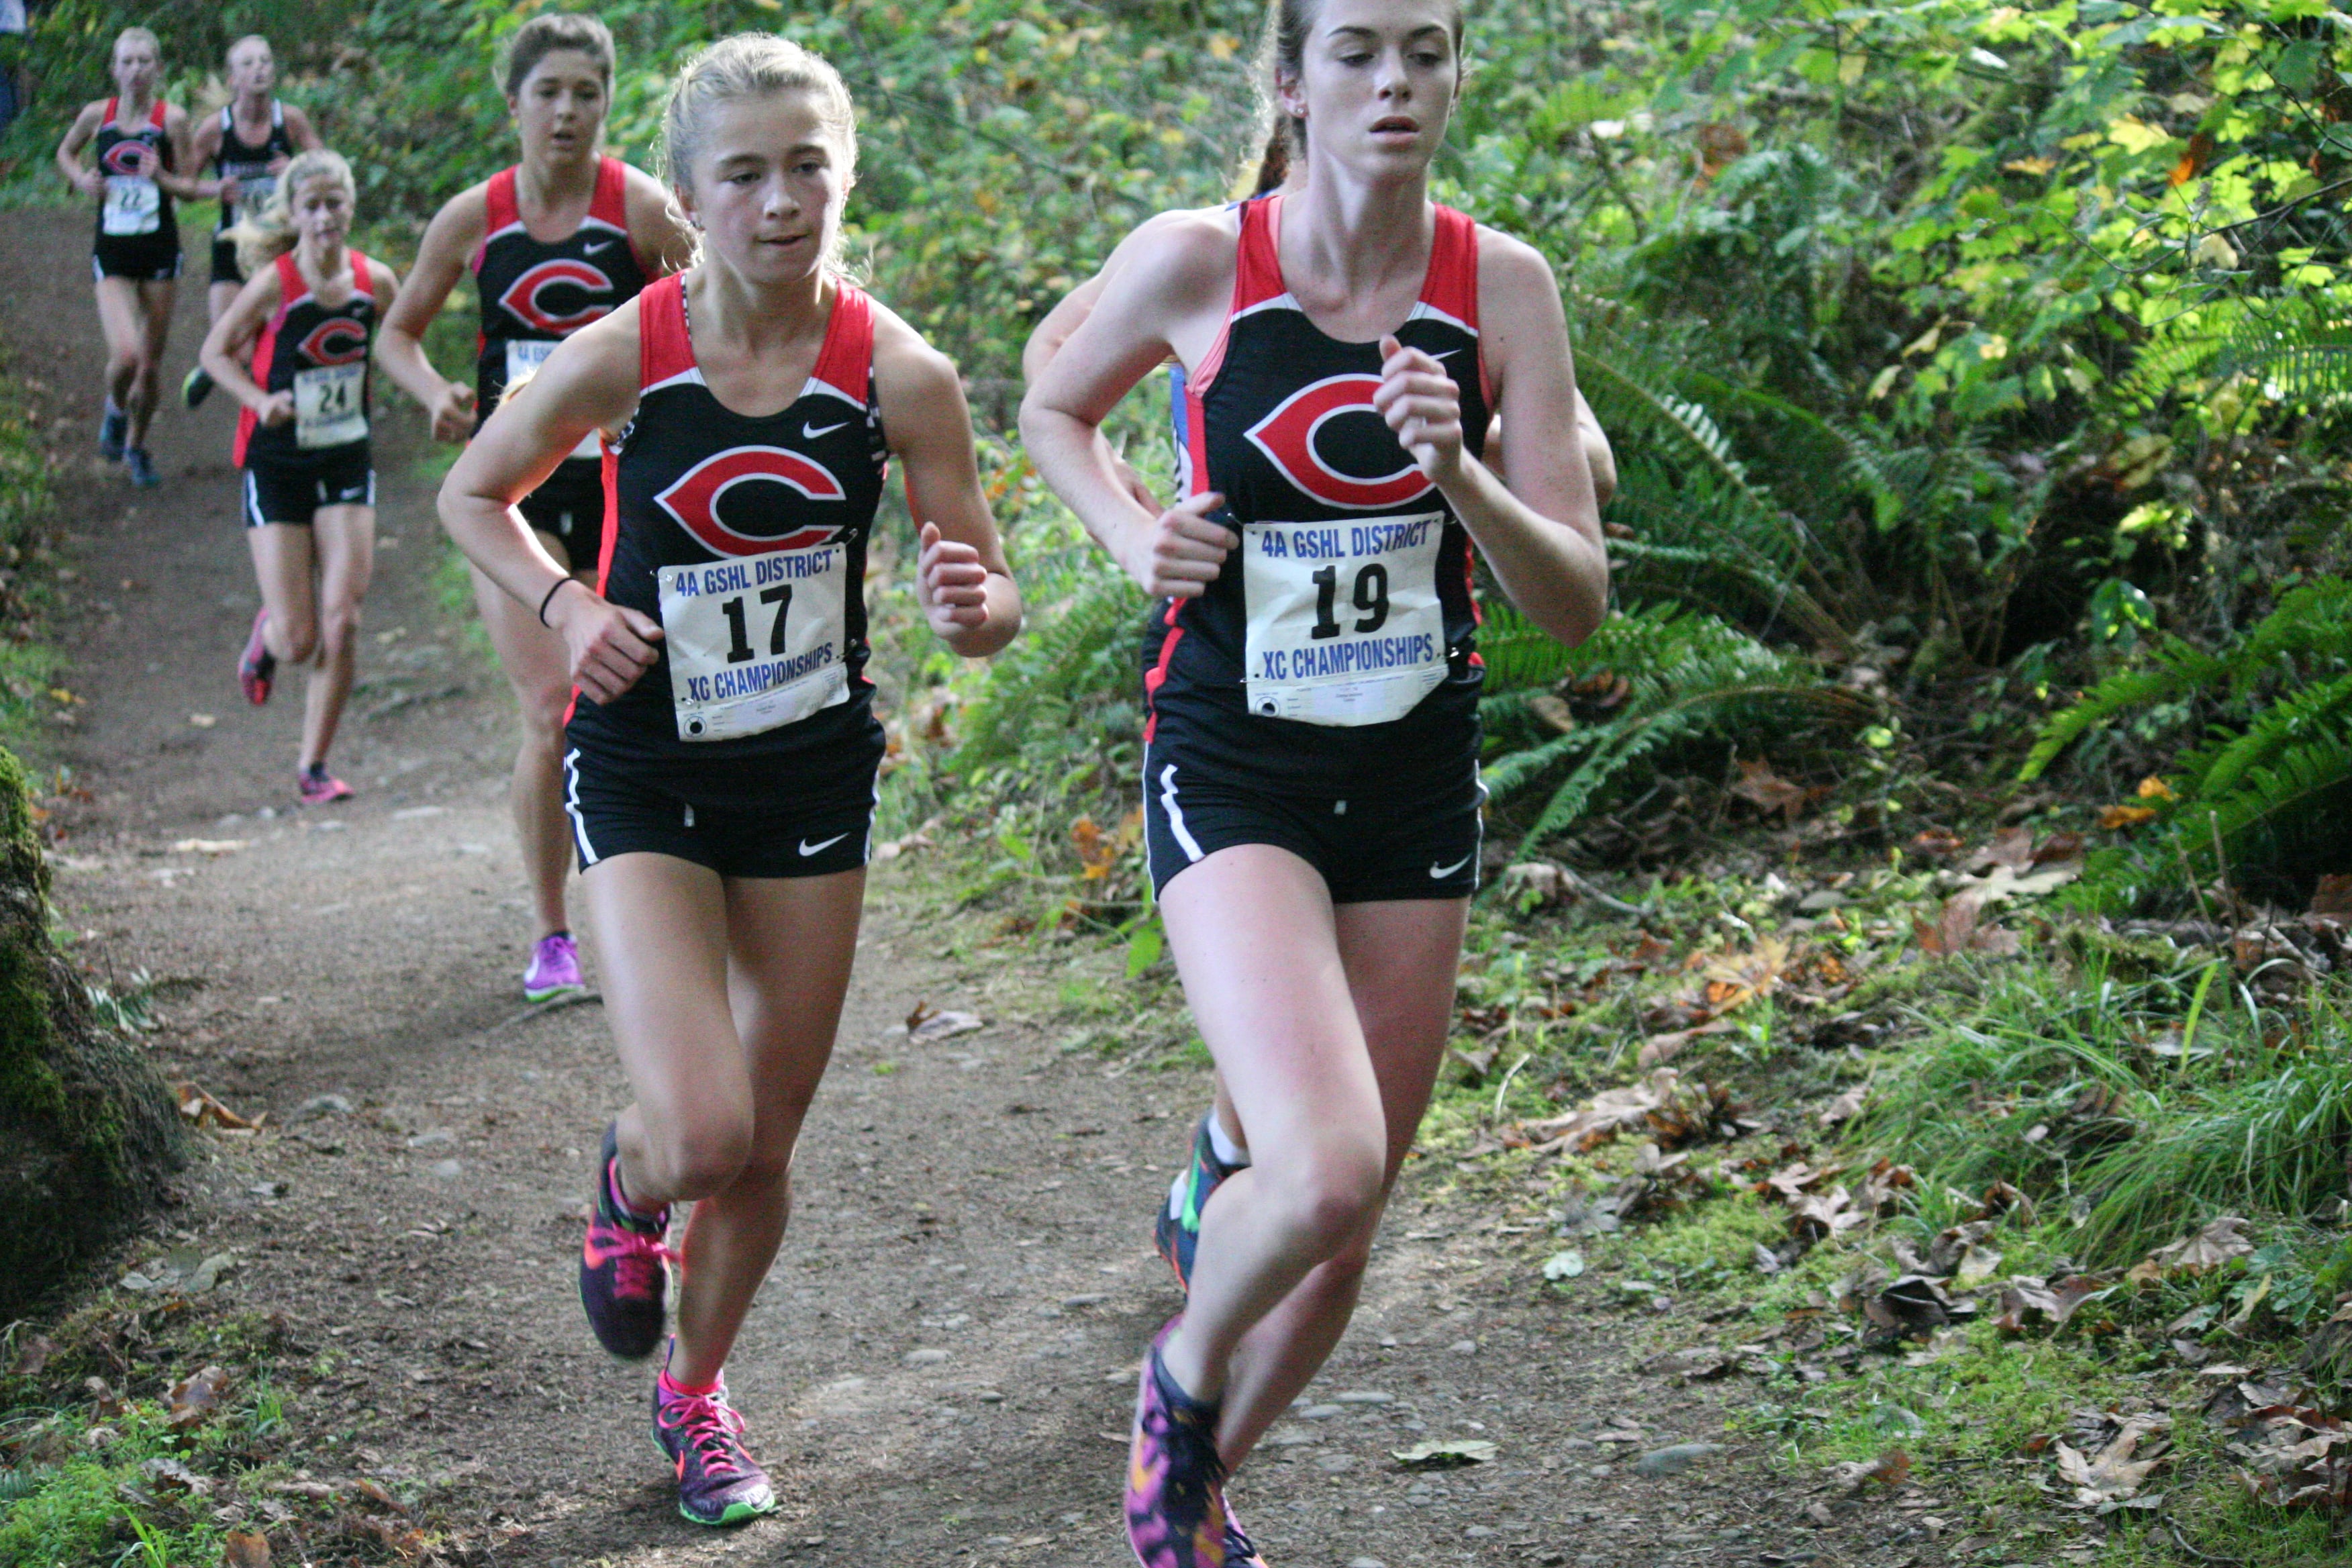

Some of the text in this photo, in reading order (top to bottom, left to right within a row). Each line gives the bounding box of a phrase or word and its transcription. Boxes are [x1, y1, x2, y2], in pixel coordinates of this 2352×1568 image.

[121, 187, 140, 210] 22
[320, 383, 346, 412] 24
[654, 445, 846, 559] C
[1262, 519, 1431, 558] 4A GSHL DISTRICT
[677, 550, 832, 597] 4A GSHL DISTRICT
[723, 584, 792, 663] 17
[1312, 564, 1388, 639] 19
[688, 676, 709, 701] XC
[715, 642, 832, 698] CHAMPIONSHIPS
[1263, 634, 1432, 679] XC CHAMPIONSHIPS
